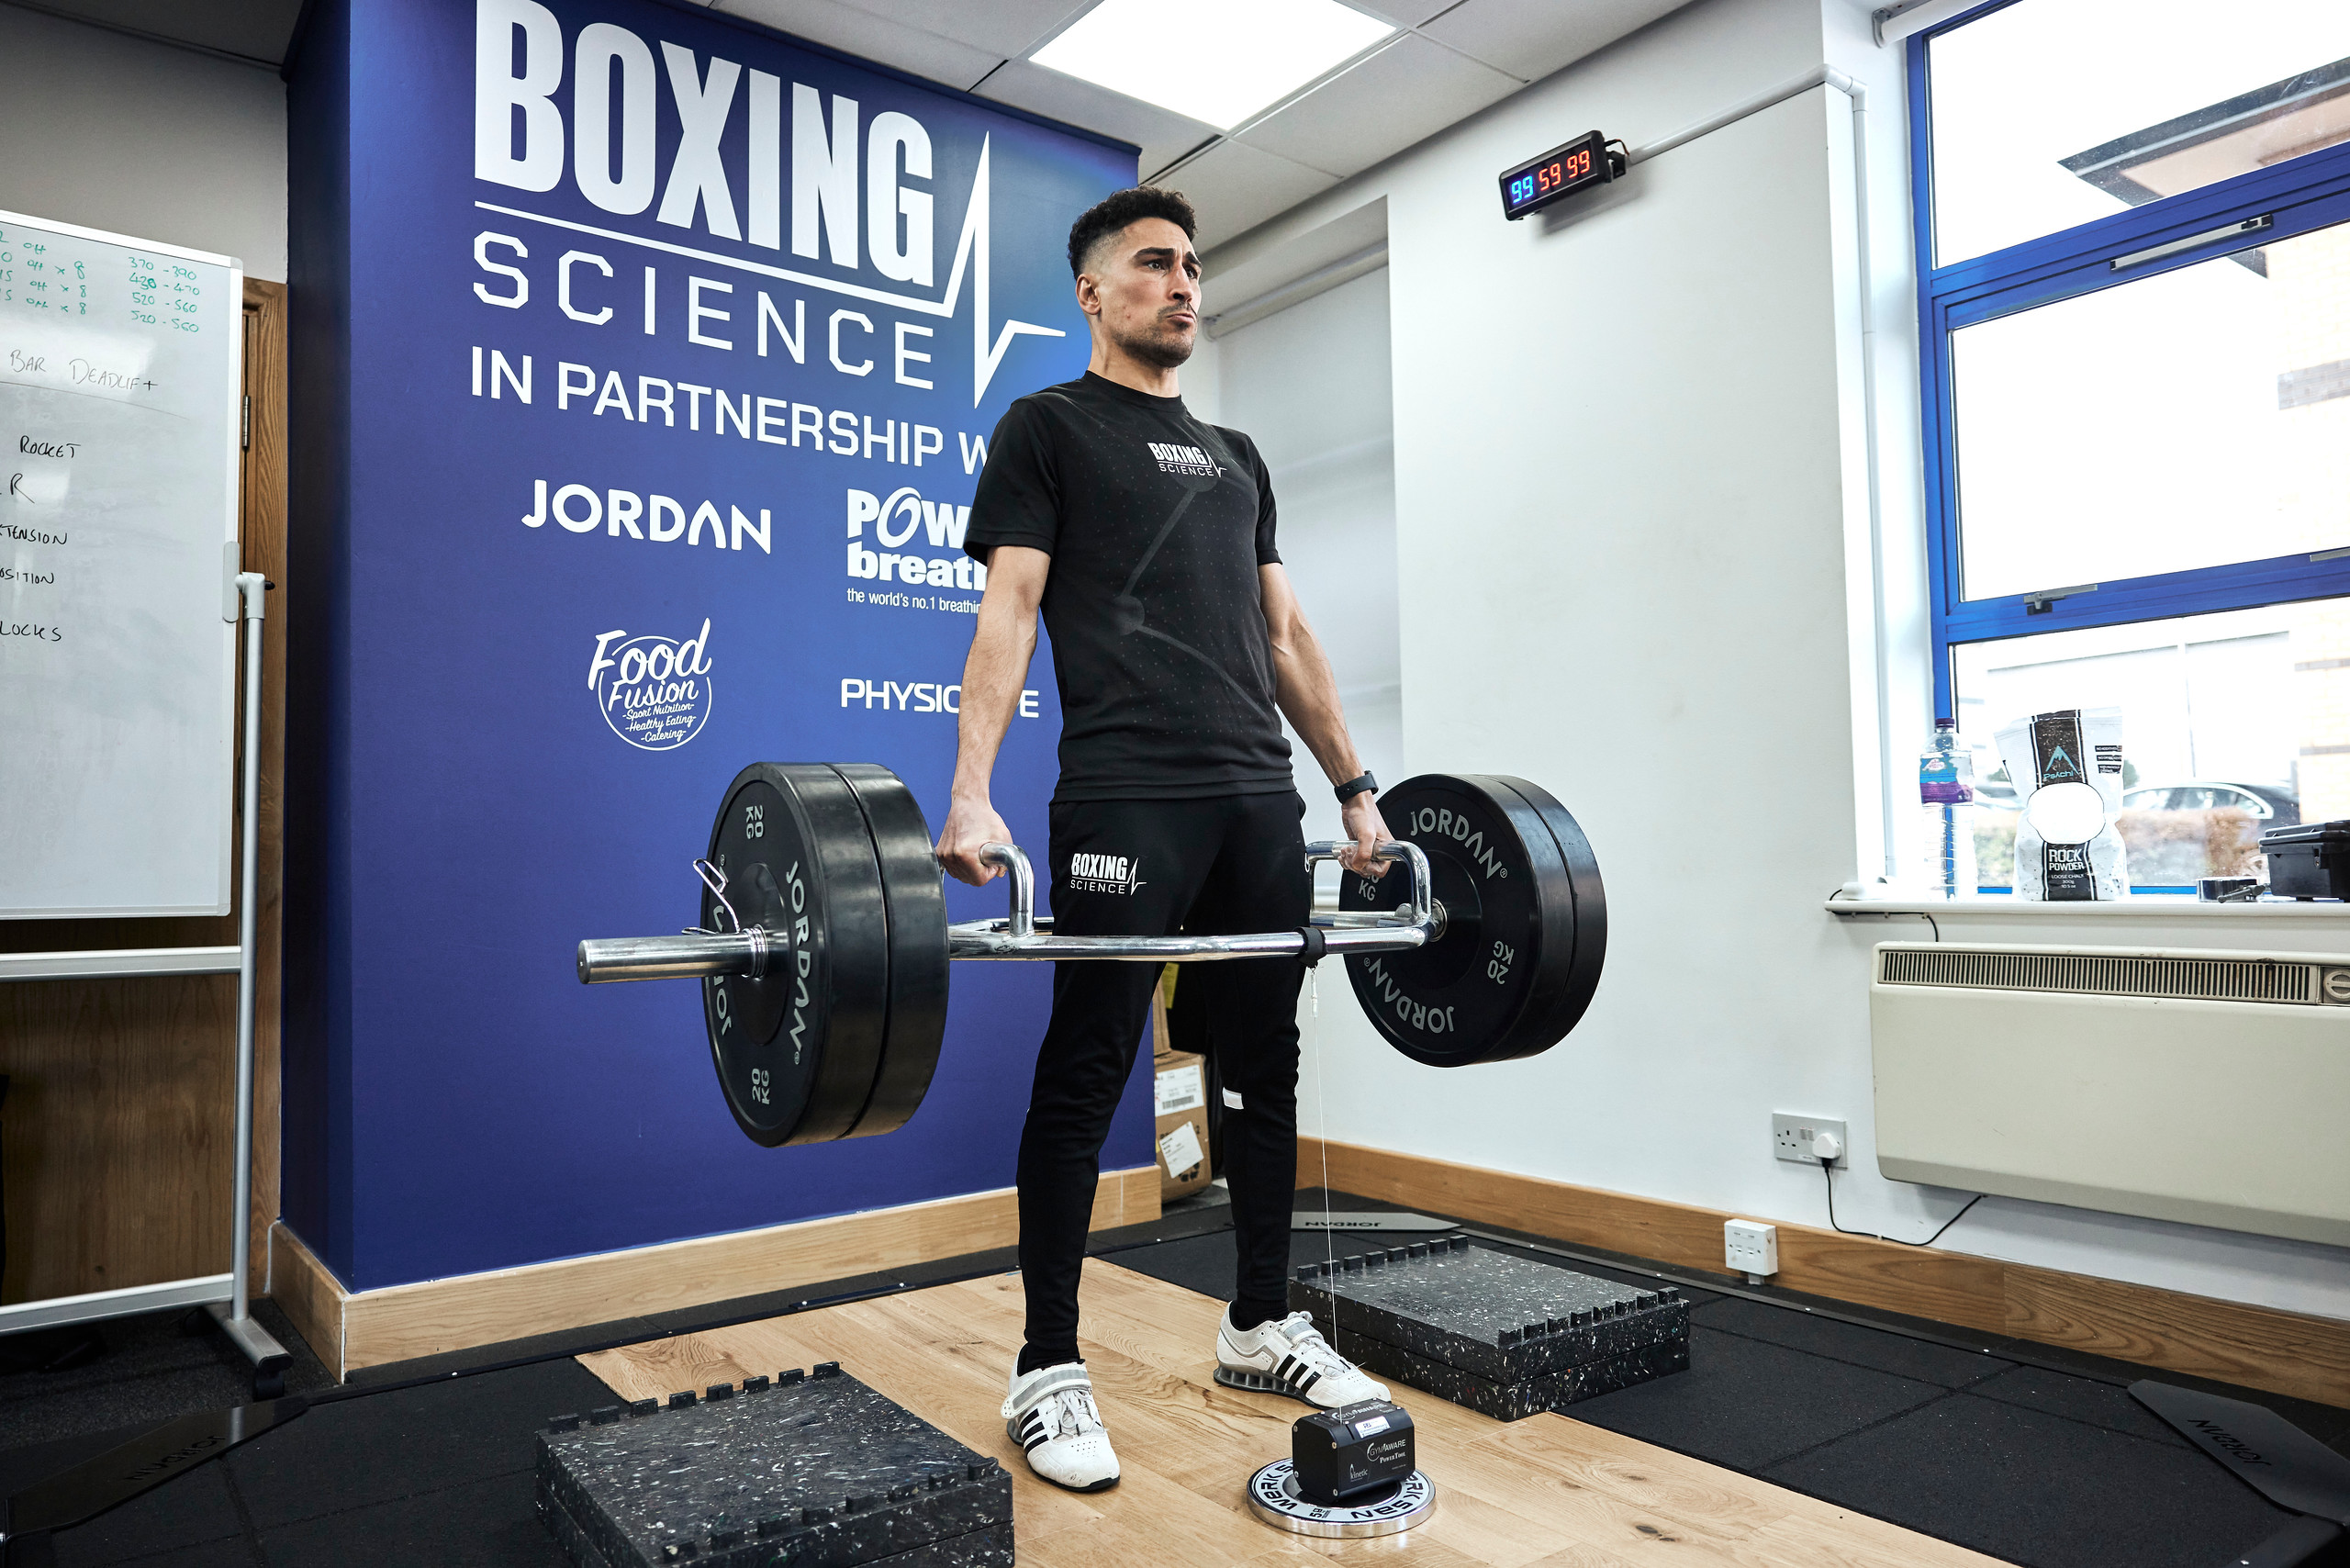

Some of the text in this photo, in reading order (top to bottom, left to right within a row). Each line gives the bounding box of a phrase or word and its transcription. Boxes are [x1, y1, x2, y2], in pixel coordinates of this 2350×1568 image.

[475, 0, 934, 287] BOXING
[1511, 150, 1590, 204] 99 59 99
[473, 230, 934, 390] SCIENCE
[10, 349, 47, 373] BAR
[471, 345, 532, 404] IN
[557, 361, 944, 467] PARTNERSHIP
[1147, 442, 1209, 465] BOXING
[1158, 463, 1214, 476] SCIENCE
[520, 479, 771, 554] JORDAN
[847, 487, 971, 549] POW
[846, 588, 866, 602] the
[868, 592, 910, 608] world's
[912, 596, 935, 610] no.1
[588, 617, 713, 691] Food
[608, 679, 699, 712] Fusion
[745, 805, 755, 840] KG
[754, 804, 764, 838] 20
[1070, 853, 1129, 880] BOXING
[2048, 848, 2083, 863] ROCK
[2048, 861, 2086, 871] POWDER
[1069, 879, 1126, 895] SCIENCE
[1358, 879, 1377, 902] KG
[1492, 939, 1515, 965] KG
[1486, 958, 1510, 985] 20
[751, 1068, 761, 1103] 20
[761, 1070, 770, 1105] KG
